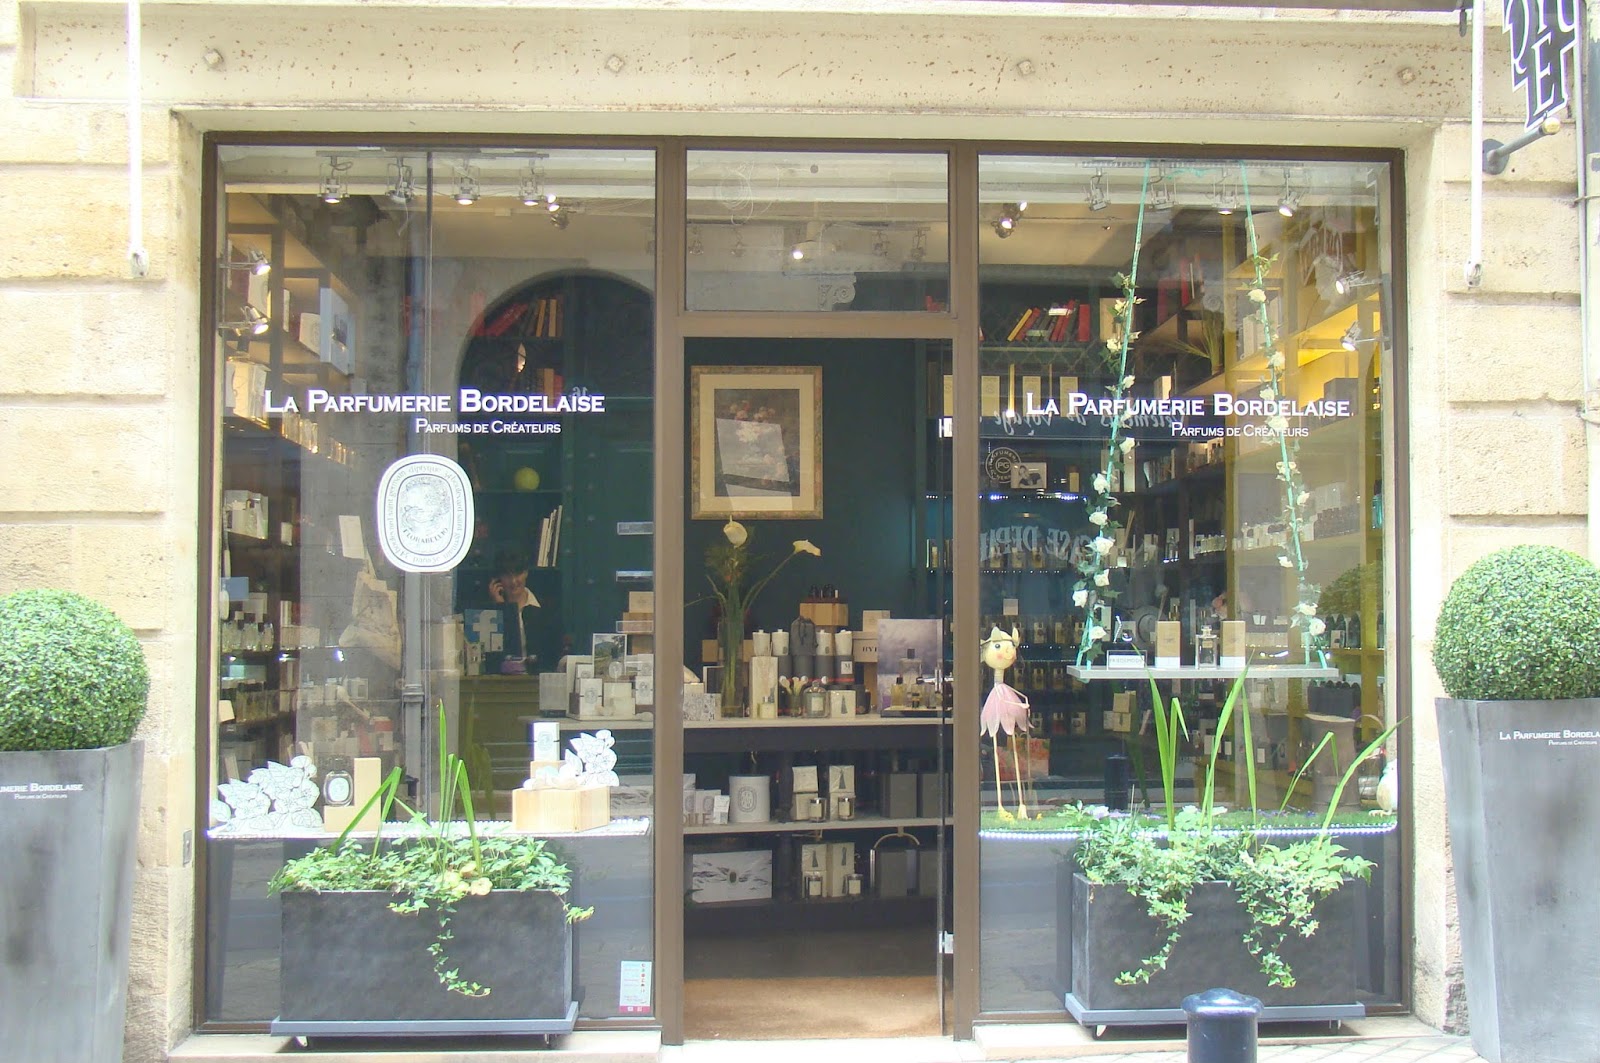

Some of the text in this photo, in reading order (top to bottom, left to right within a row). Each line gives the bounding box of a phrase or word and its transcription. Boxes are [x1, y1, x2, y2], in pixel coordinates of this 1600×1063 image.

[262, 388, 605, 412] LA PARFUMERIE BORDELAISE
[1026, 392, 1351, 417] LA PARFUMERIE BORDELAISE
[415, 418, 561, 434] PARFUMS DE CRÉATEURS
[1171, 421, 1224, 437] PARFUMS
[1226, 427, 1241, 437] DE
[1513, 730, 1561, 740] PARFUMERIE
[30, 783, 84, 792] BORDELAISE
